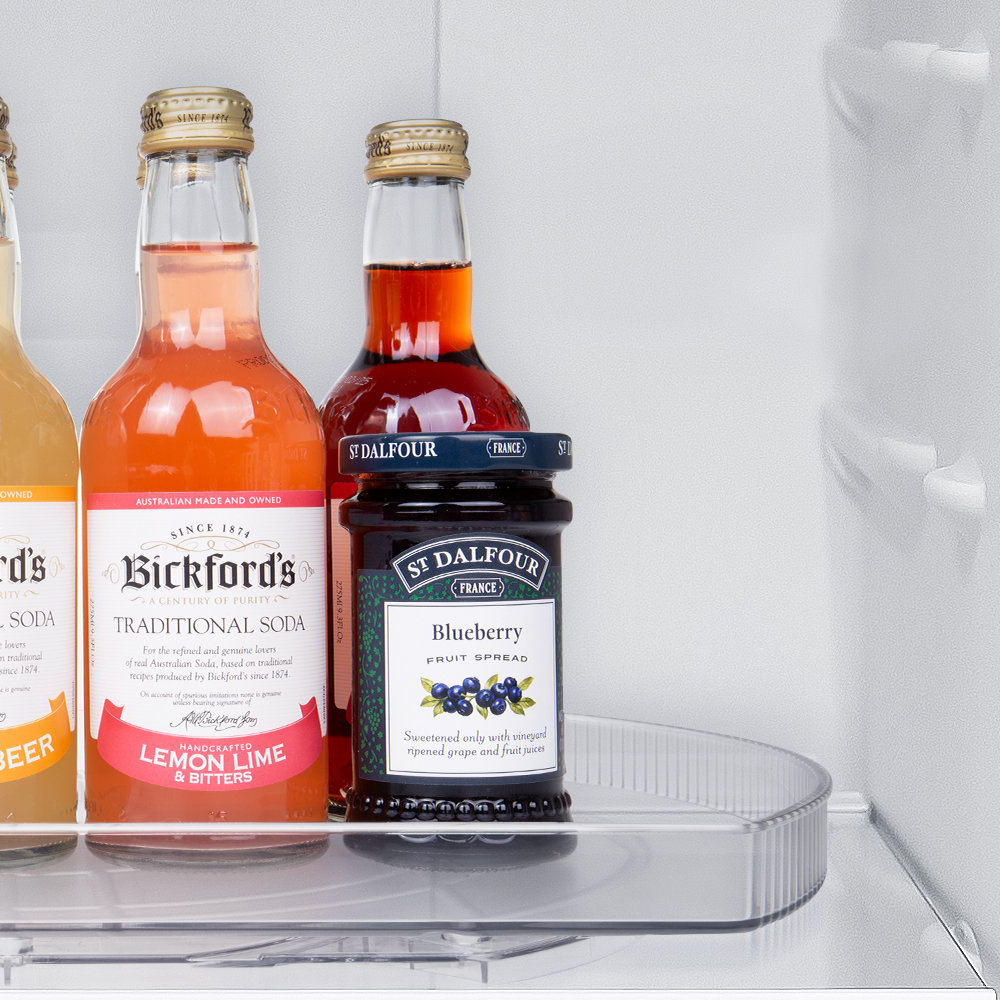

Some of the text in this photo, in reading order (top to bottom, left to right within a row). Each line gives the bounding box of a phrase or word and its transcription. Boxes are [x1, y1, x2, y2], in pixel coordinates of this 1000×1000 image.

[177, 114, 206, 122] SINCE
[361, 441, 438, 459] DALFOUR
[493, 442, 521, 454] FRANCE
[136, 498, 191, 506] AUSTRALIAN
[195, 497, 222, 505] MADE
[249, 496, 281, 504] OWNED
[171, 523, 251, 540] SINCE 1874
[434, 546, 539, 577] DALFOUR
[121, 552, 296, 593] Bickford's
[460, 582, 497, 594] FRANCE
[149, 596, 270, 605] A CENTURY OF PURITY
[10, 610, 55, 628] SODA
[114, 615, 305, 634] TRADITIONAL SODA
[432, 623, 522, 644] Blueberry
[5, 640, 26, 649] lovers
[7, 651, 42, 662] traditional
[143, 646, 276, 656] For the refined and genuine lovers
[126, 658, 132, 667] of
[134, 659, 148, 667] real
[150, 659, 192, 668] Australian
[195, 659, 219, 668] Soda,
[221, 659, 243, 667] based
[258, 656, 292, 667] traditional
[427, 654, 528, 664] FRUIT SPREAD
[0, 666, 18, 675] since
[20, 665, 40, 674] 1874.
[130, 670, 291, 682] recipes produced by Bickford's since 1874.
[404, 726, 547, 744] Sweetened only with vineyard
[180, 743, 252, 753] HANDCRAFTED
[408, 743, 545, 758] ripened grape and fruit juices
[140, 743, 286, 771] LEMON LIME
[174, 771, 252, 785] & BITTERS
